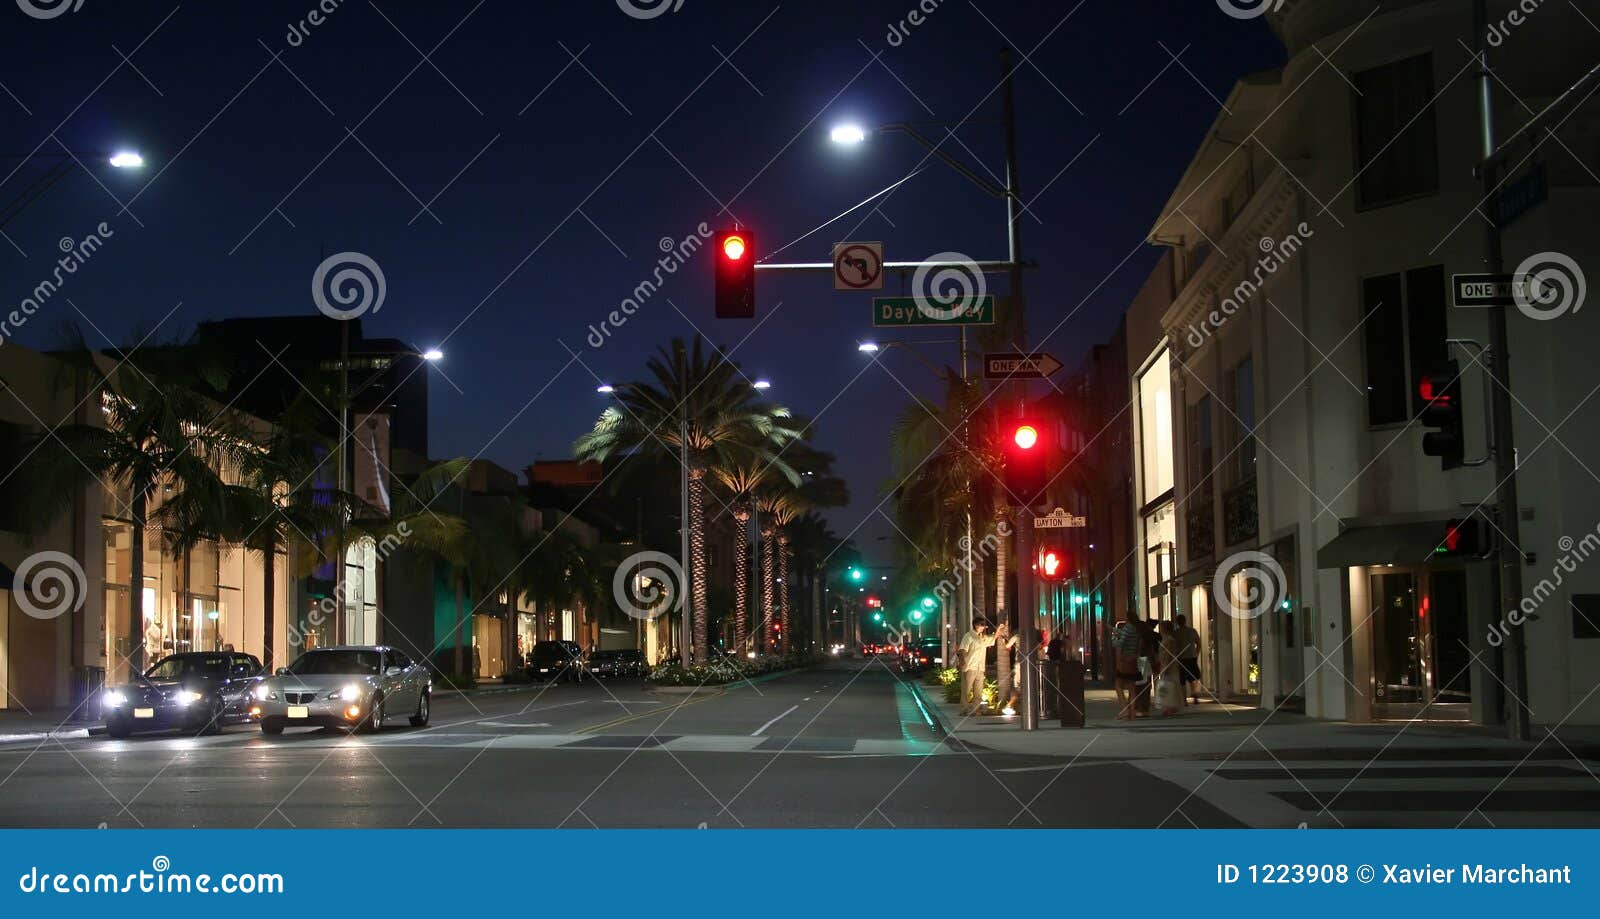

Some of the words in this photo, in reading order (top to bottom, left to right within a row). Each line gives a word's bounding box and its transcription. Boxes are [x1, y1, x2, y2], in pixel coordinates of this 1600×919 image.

[1465, 284, 1493, 297] ONE
[1497, 284, 1525, 297] WAY
[882, 304, 945, 323] Dayton
[951, 303, 984, 321] Way
[992, 360, 1016, 371] ONE
[1019, 359, 1041, 371] WAY
[1036, 518, 1063, 527] DAYTON
